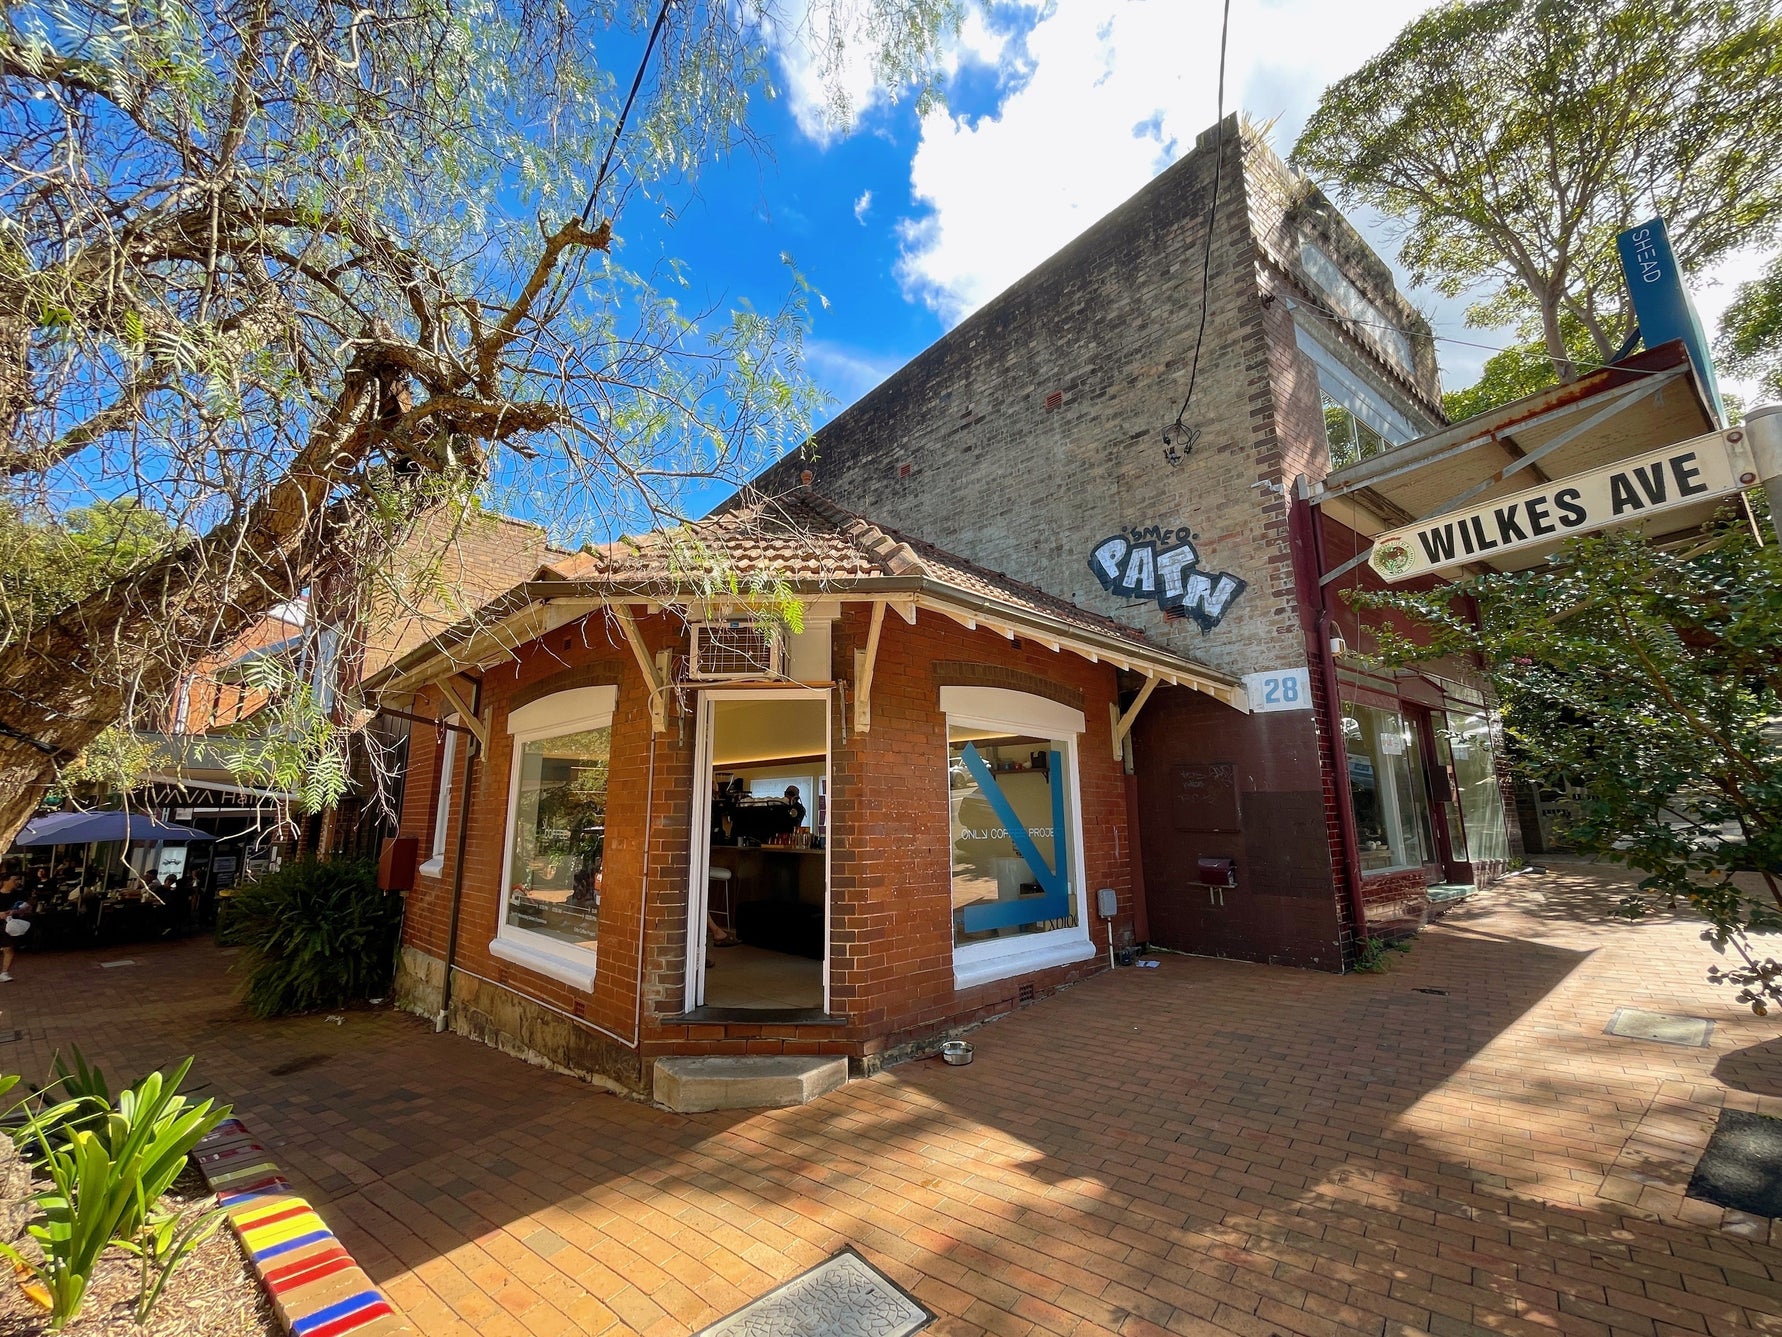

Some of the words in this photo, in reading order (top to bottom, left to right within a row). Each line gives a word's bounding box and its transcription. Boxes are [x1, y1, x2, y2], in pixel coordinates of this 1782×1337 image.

[1632, 229, 1661, 283] SHEAD
[1418, 488, 1587, 564] WILKES
[1609, 452, 1707, 516] AVE
[1264, 677, 1299, 704] 28
